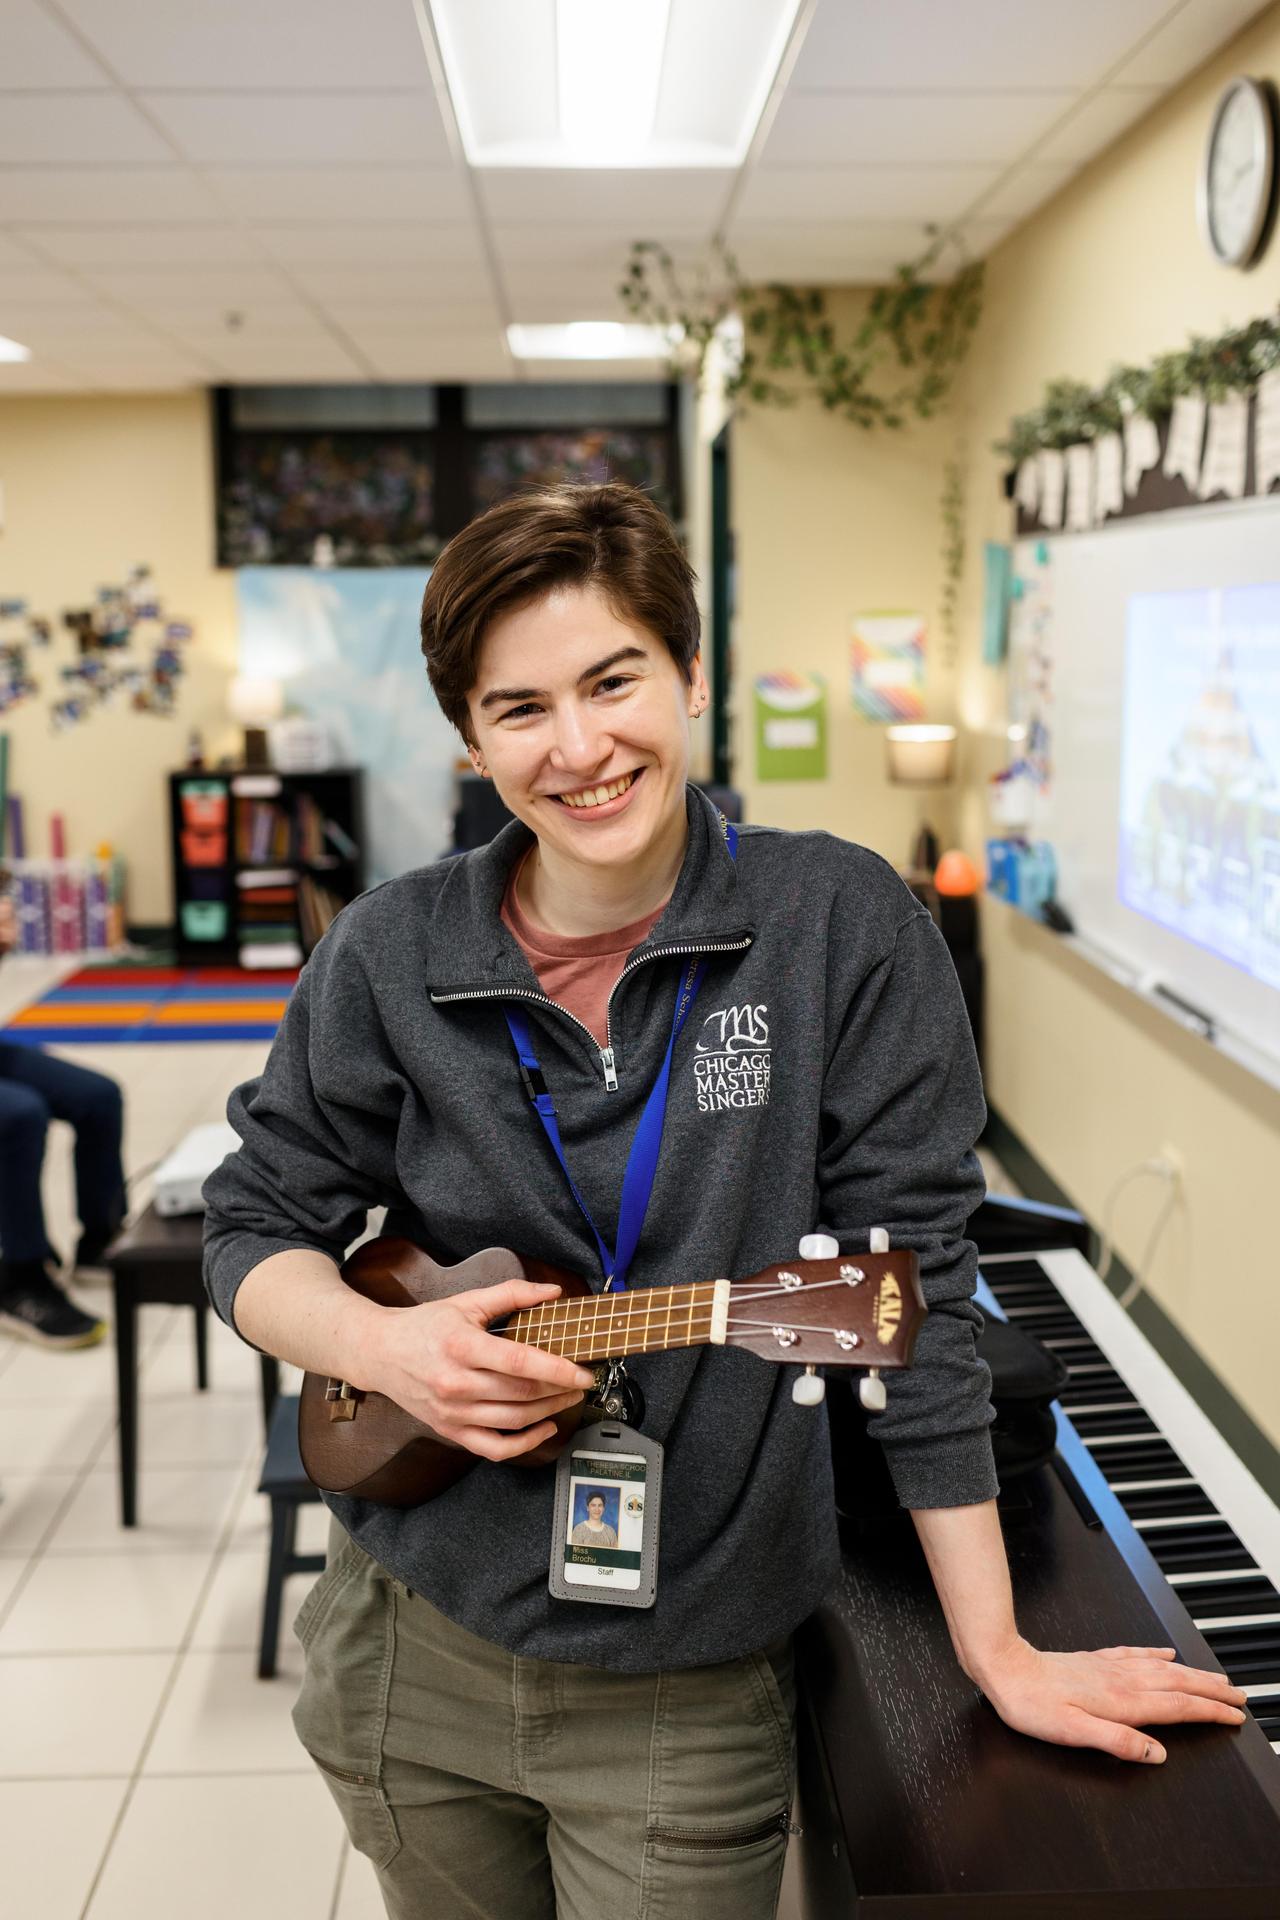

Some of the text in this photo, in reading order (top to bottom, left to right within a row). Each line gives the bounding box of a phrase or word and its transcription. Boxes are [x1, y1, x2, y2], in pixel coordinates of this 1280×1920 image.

[877, 1271, 903, 1346] KALA
[620, 1463, 646, 1472] SCHOO
[572, 1546, 589, 1555] Miss
[572, 1554, 597, 1564] Brochu
[597, 1567, 614, 1576] Staff
